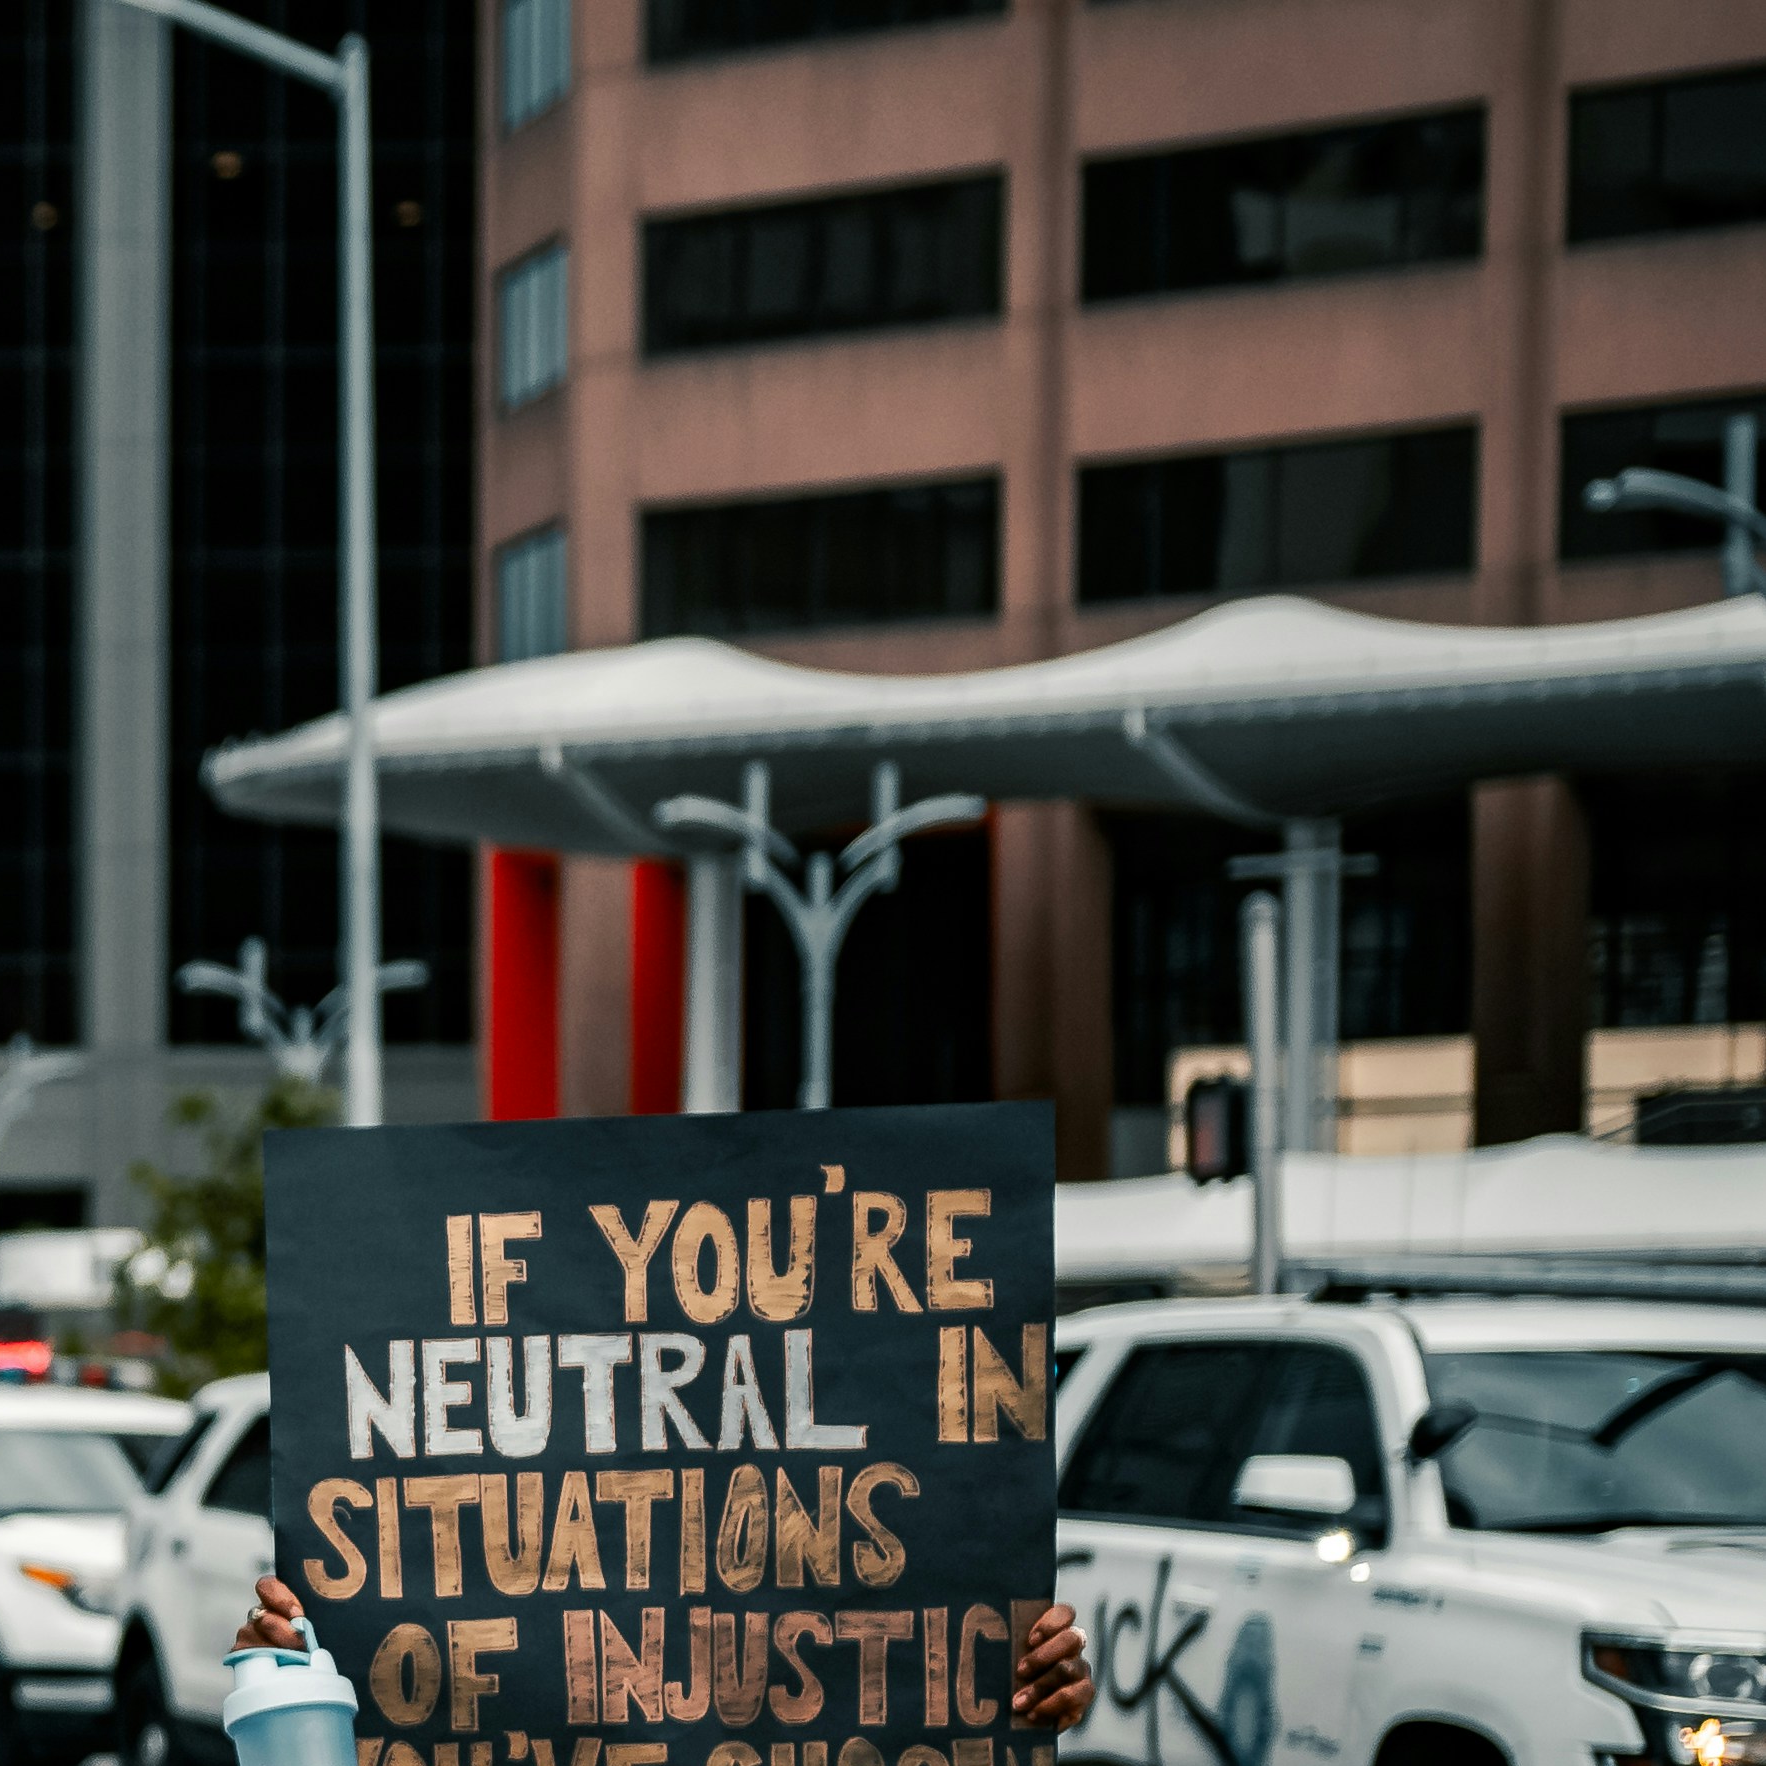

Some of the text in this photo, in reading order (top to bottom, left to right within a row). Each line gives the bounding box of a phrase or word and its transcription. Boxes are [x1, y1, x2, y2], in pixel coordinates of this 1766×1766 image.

[447, 1164, 993, 1327] IF YOU'RE
[344, 1323, 1047, 1460] NEUTRAL IN
[303, 1463, 921, 1600] SITUATIONS
[369, 1616, 520, 1732] OF
